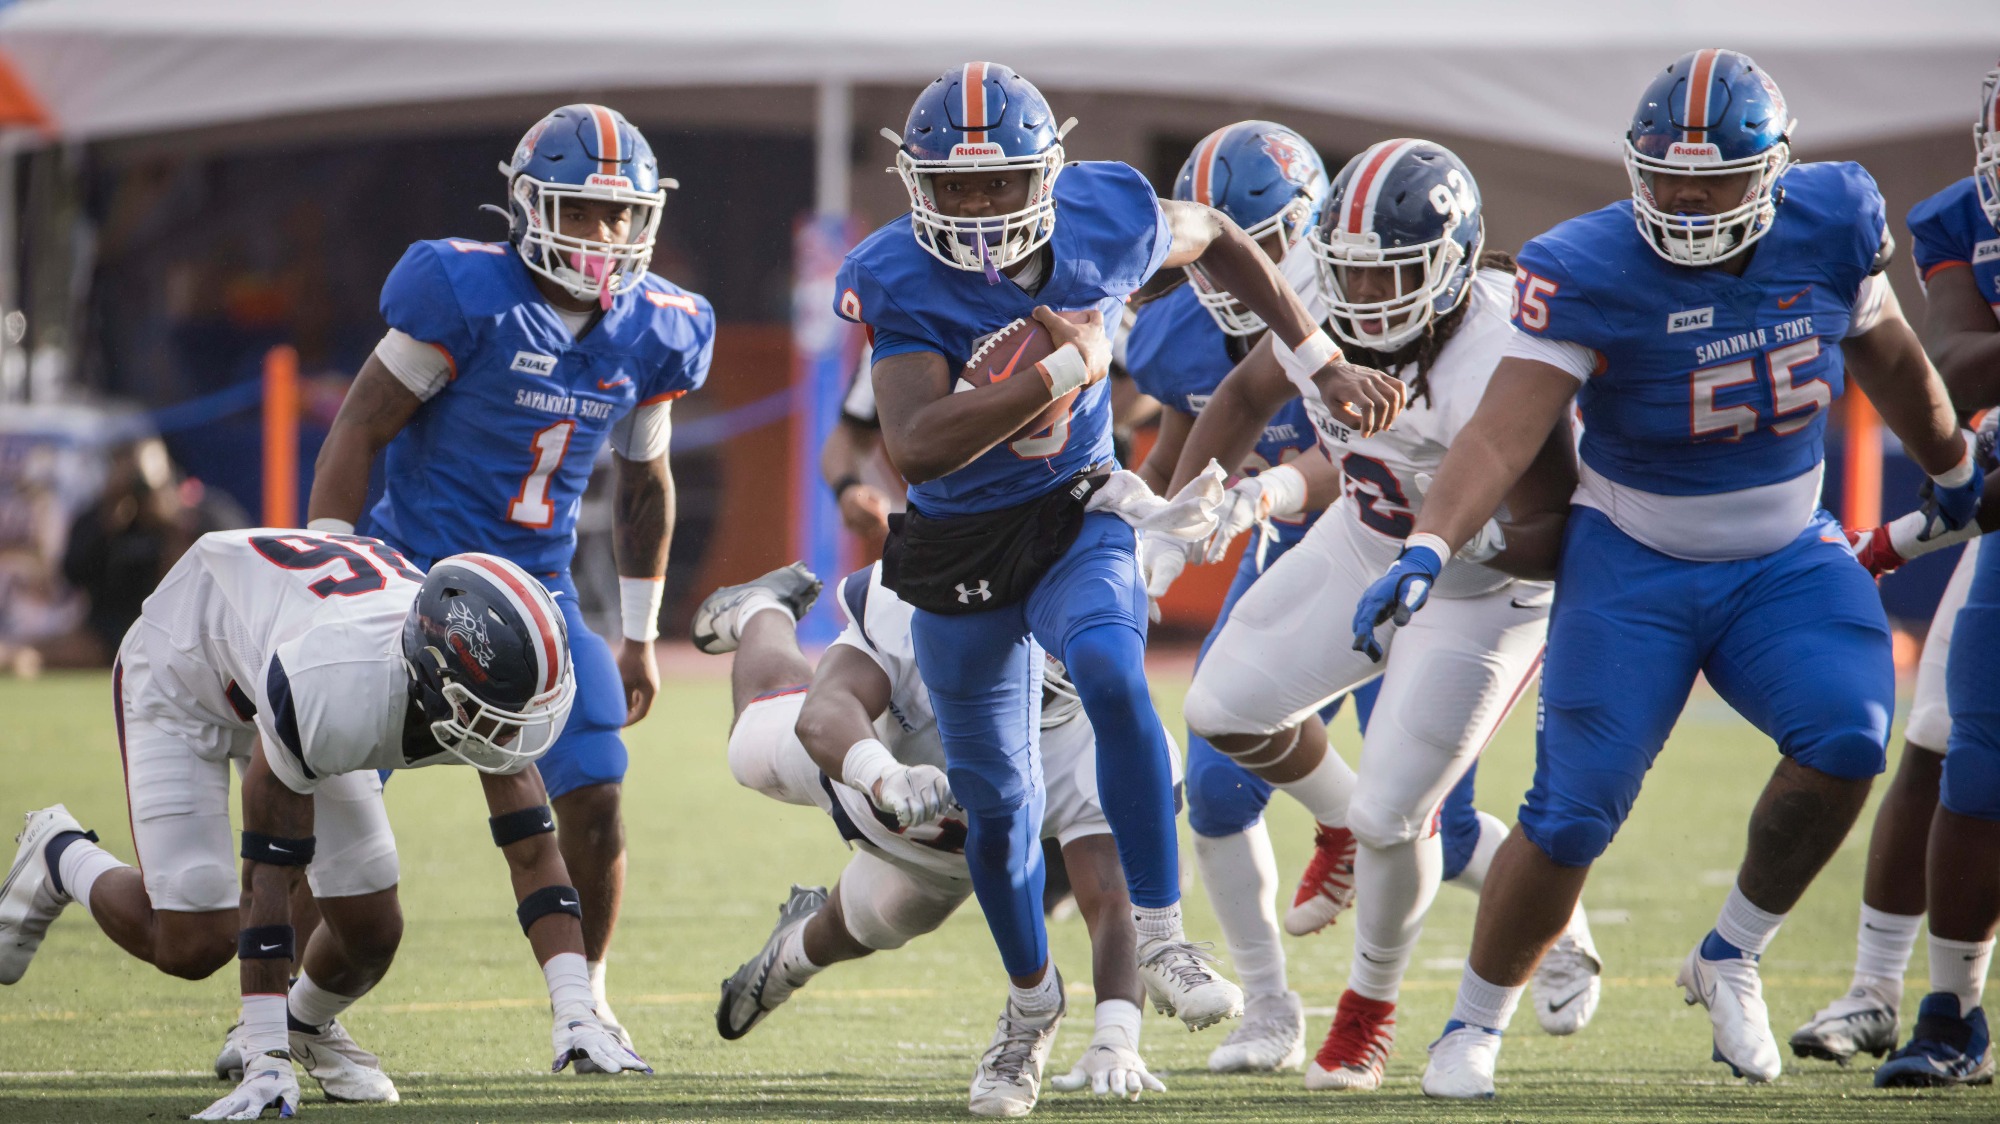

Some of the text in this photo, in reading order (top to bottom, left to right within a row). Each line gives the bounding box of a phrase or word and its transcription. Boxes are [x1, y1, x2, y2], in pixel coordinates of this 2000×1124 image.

[955, 147, 998, 156] Riddell
[1673, 146, 1713, 156] Riddell
[591, 176, 628, 188] Riddell
[1428, 168, 1477, 227] 92
[1977, 243, 2000, 257] SIA
[646, 290, 699, 316] 1
[1510, 265, 1559, 333] 55
[1673, 313, 1709, 329] SIAC
[1696, 316, 1814, 365] SAVANNAH STATE
[516, 356, 550, 372] SIAC
[514, 388, 614, 420] SAVANNAH STATE
[1689, 335, 1832, 444] 55
[505, 418, 577, 529] 1
[1341, 451, 1415, 540] 2
